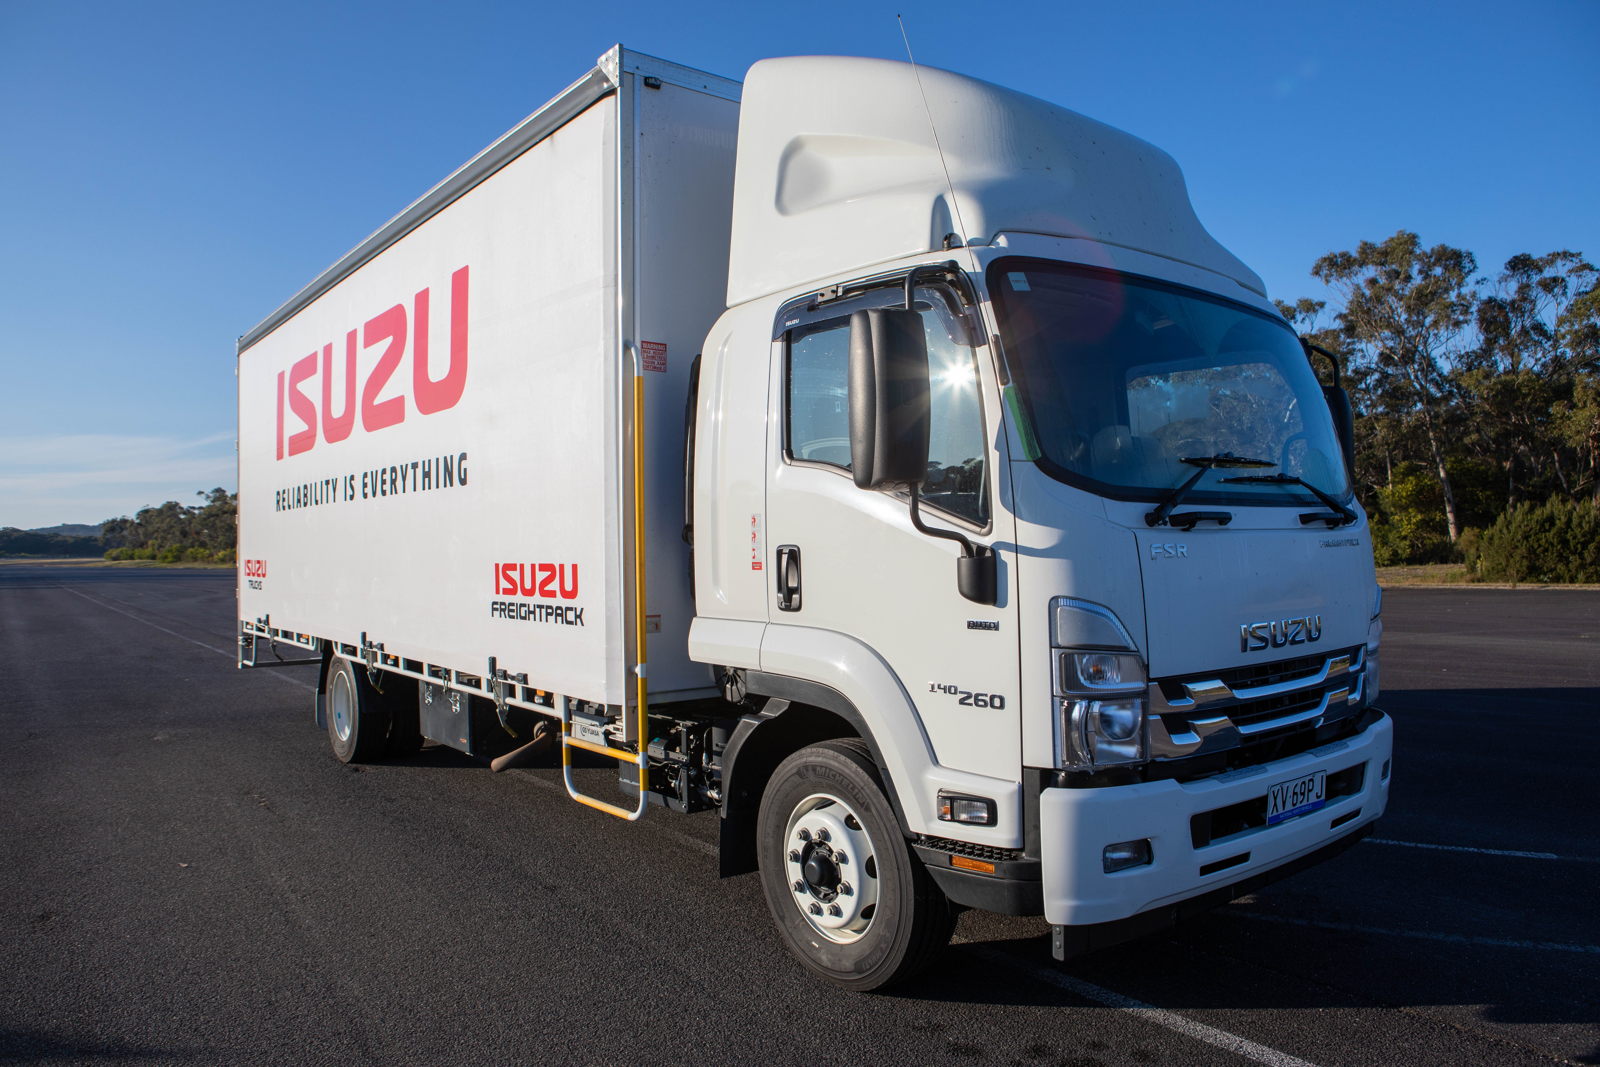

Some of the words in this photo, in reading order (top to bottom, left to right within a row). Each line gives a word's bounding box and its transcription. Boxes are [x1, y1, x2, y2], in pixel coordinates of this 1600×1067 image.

[276, 264, 470, 462] ISUZU
[275, 477, 338, 512] RELIABILITY
[344, 474, 355, 501] IS
[362, 452, 468, 499] EVERYTHING
[1150, 543, 1189, 560] FSR
[244, 559, 267, 578] ISUZU
[494, 562, 579, 600] ISUZU
[491, 600, 585, 627] FREIGHTPACK
[967, 620, 999, 631] AUTO
[1240, 615, 1322, 653] ISUZU
[958, 691, 1006, 710] 260
[815, 765, 871, 810] MICHELIN
